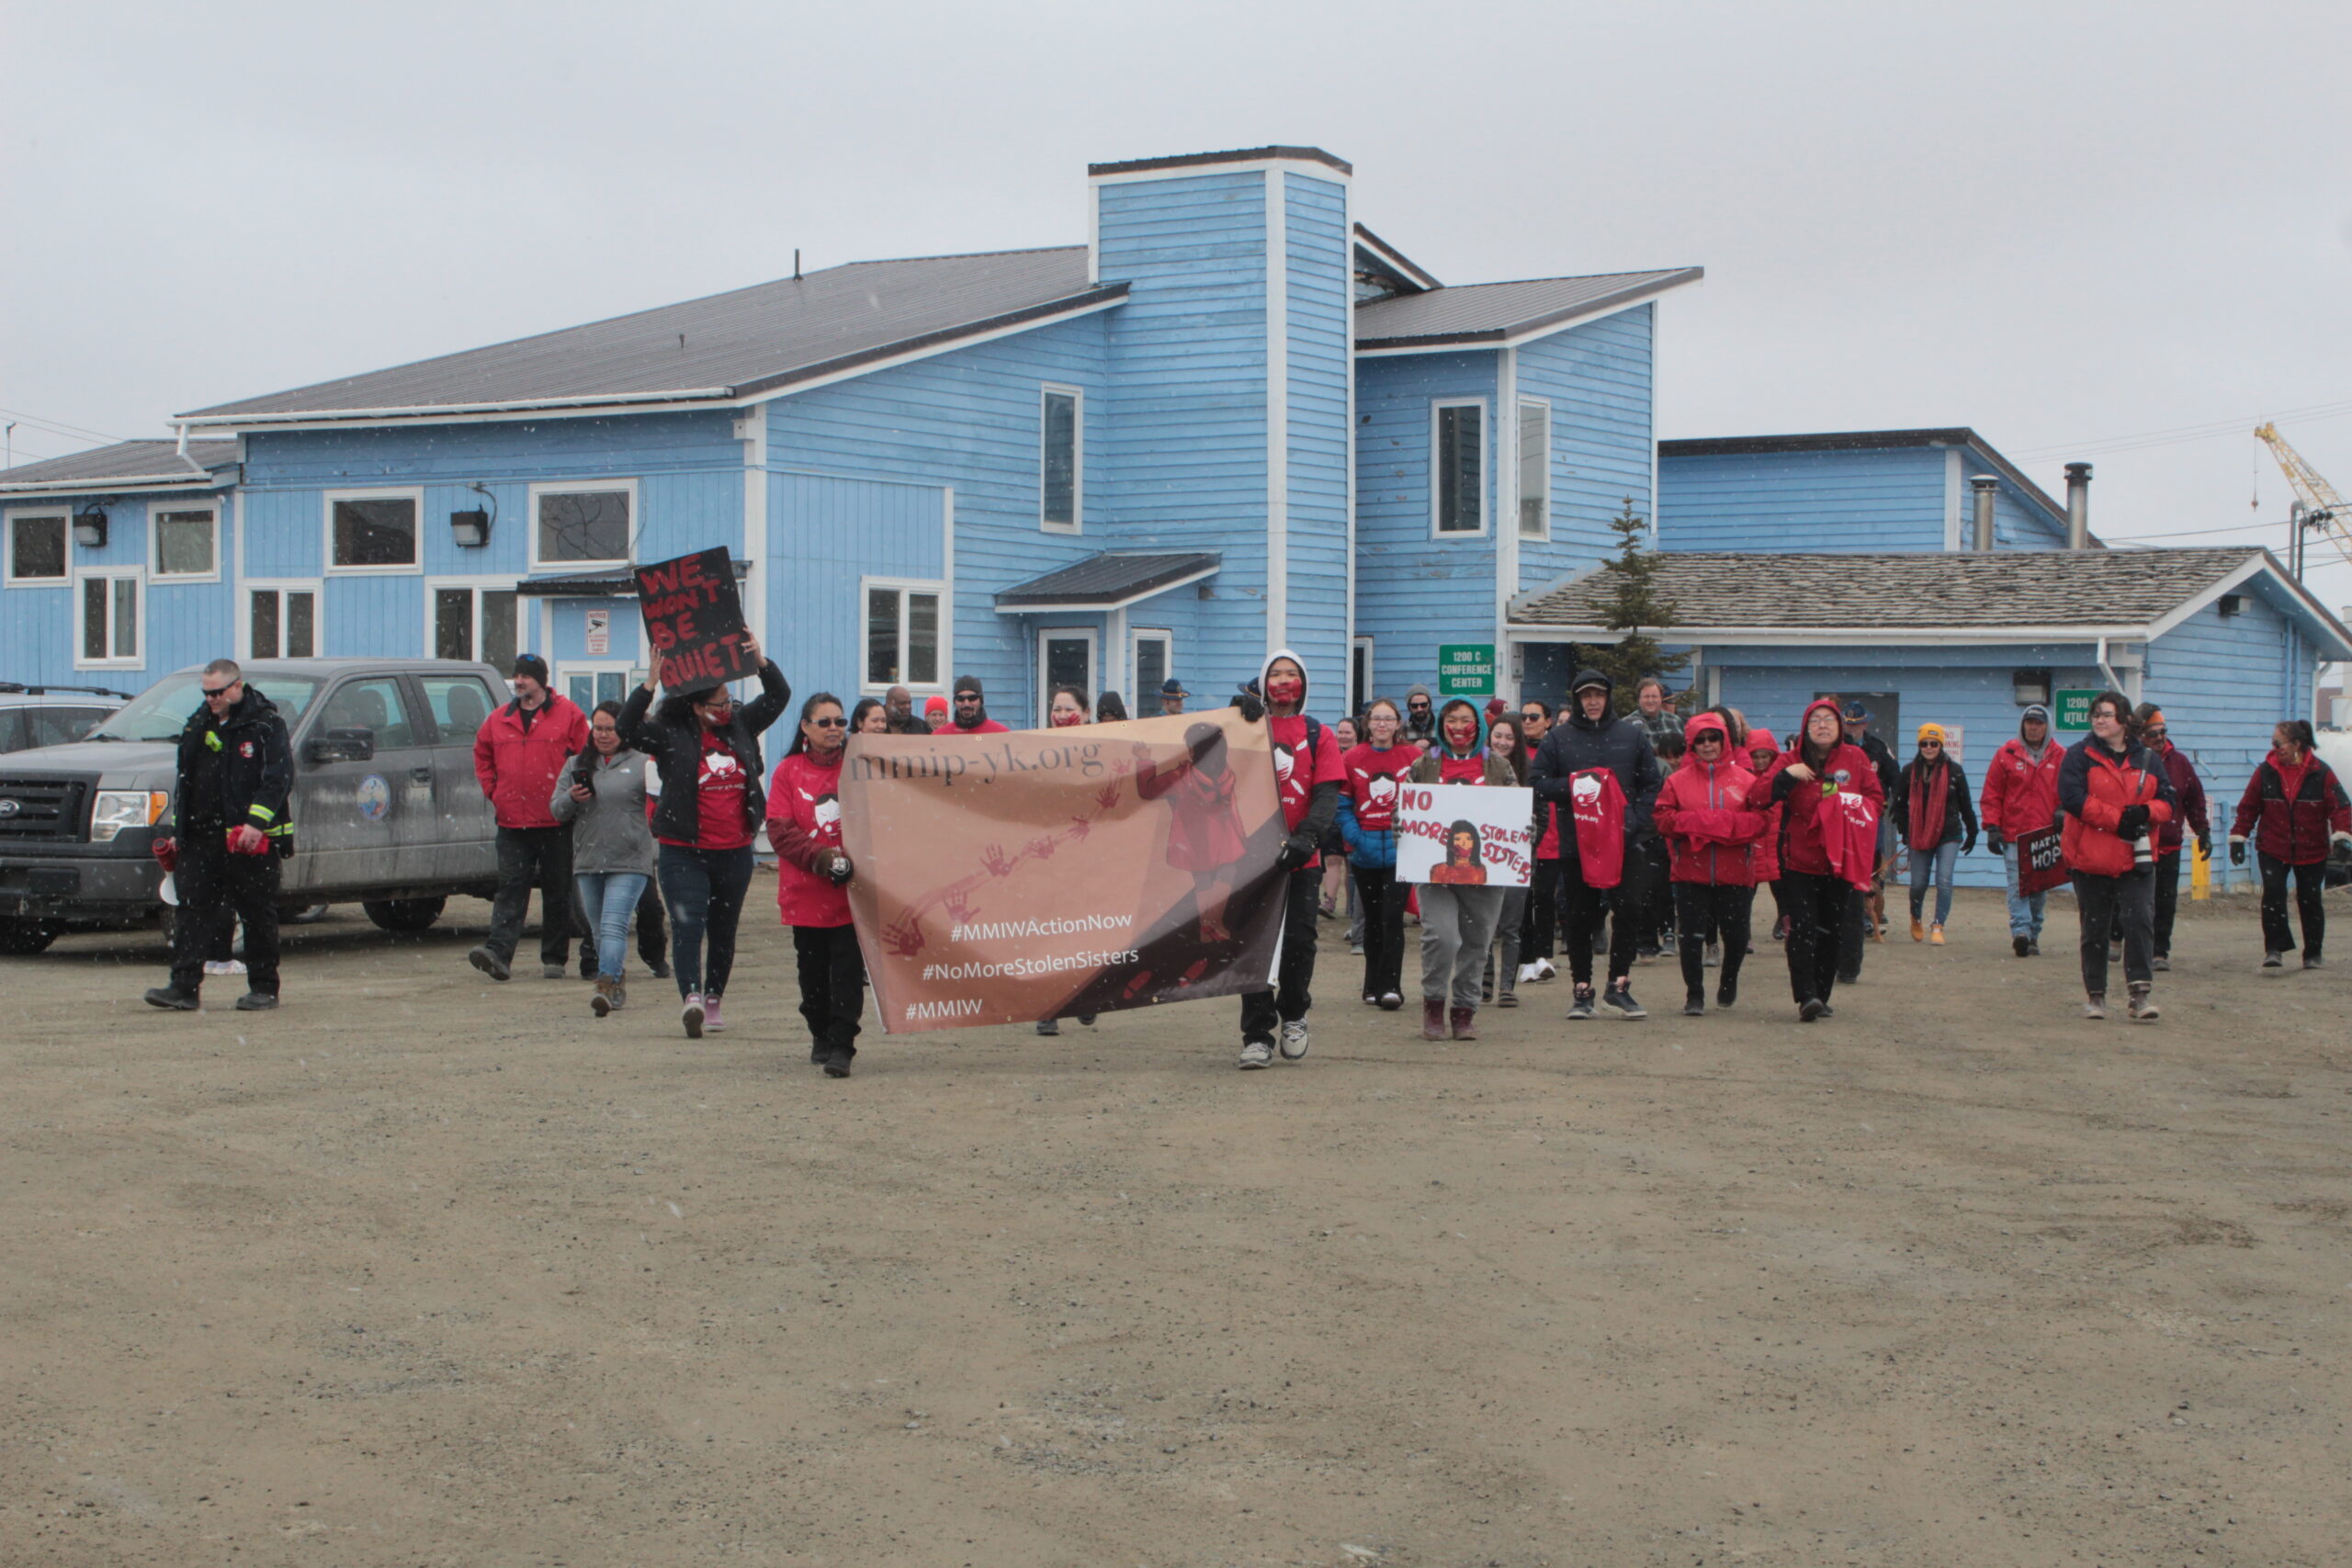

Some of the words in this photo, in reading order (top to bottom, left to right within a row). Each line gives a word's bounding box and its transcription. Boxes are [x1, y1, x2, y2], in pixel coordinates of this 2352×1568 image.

[639, 553, 705, 595] WE
[650, 611, 699, 650] BE
[660, 633, 741, 687] QUIET
[1453, 651, 1472, 661] 1200
[1475, 651, 1481, 661] C
[1442, 664, 1492, 675] CONFERENCE
[1452, 677, 1483, 688] CENTER
[2067, 697, 2088, 708] 1200
[850, 743, 1102, 786] mmip-yk.org
[1401, 789, 1432, 811] NO
[1400, 818, 1452, 845] MORE
[1479, 823, 1532, 843] STOLEN
[2032, 846, 2062, 869] HOP
[951, 914, 1132, 942] #MMIWActionNow
[922, 949, 1139, 981] #NoMoreStolenSisters
[905, 998, 983, 1021] #MMIW
